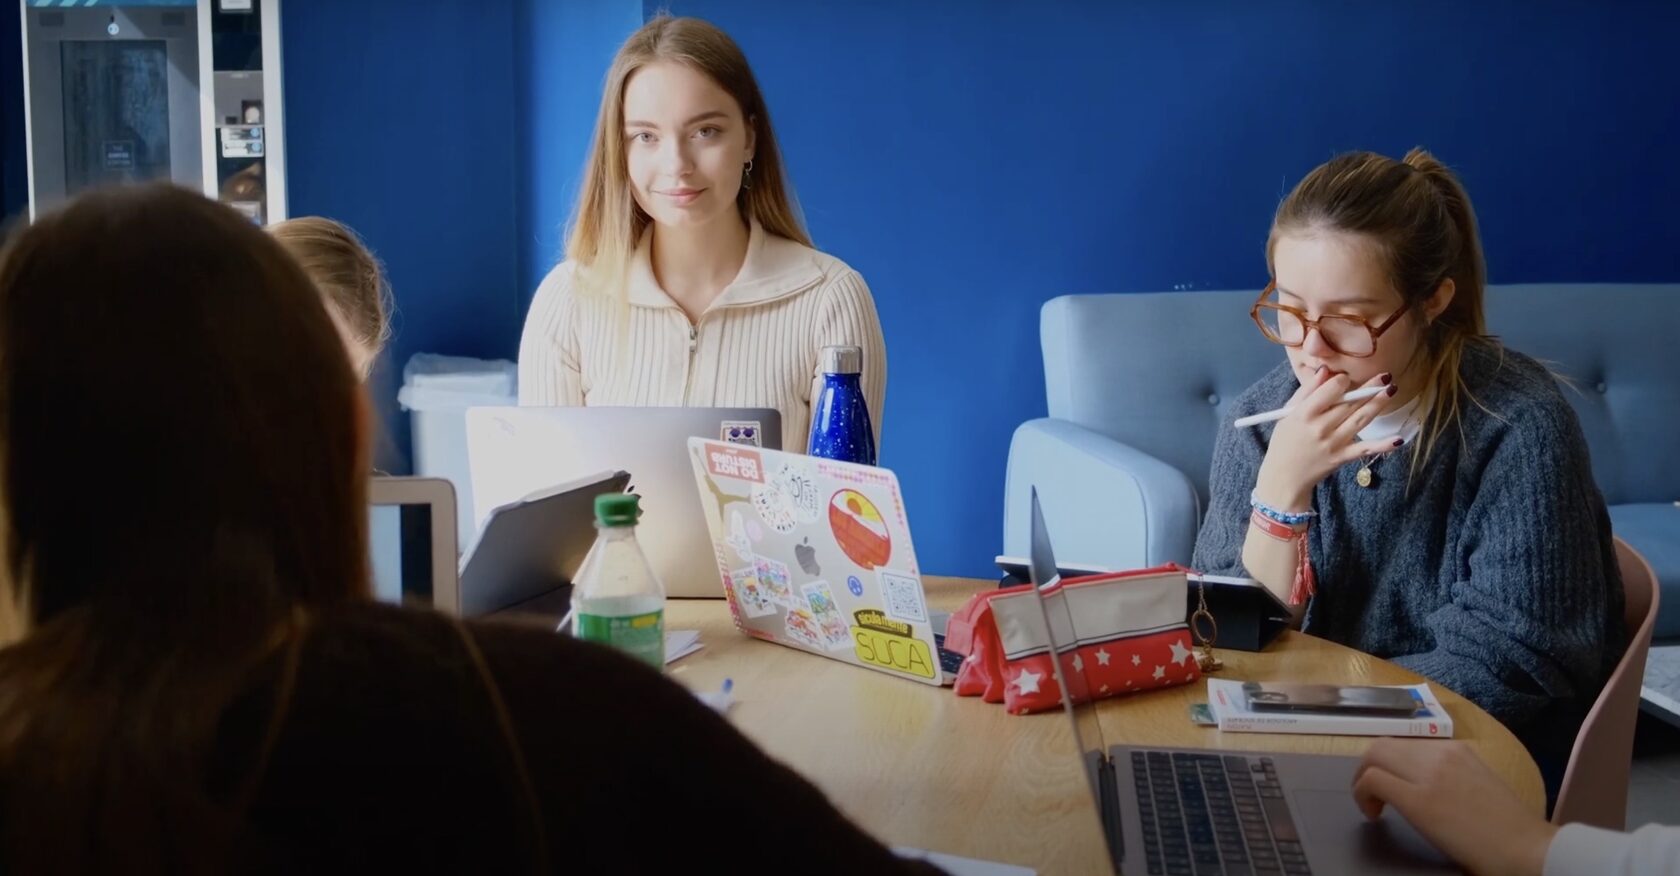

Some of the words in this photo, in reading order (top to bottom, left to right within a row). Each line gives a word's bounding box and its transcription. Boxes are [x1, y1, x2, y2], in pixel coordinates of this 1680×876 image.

[711, 451, 757, 469] DISTURB
[714, 463, 740, 476] NOT
[741, 467, 759, 480] DO
[856, 632, 930, 675] SUCA
